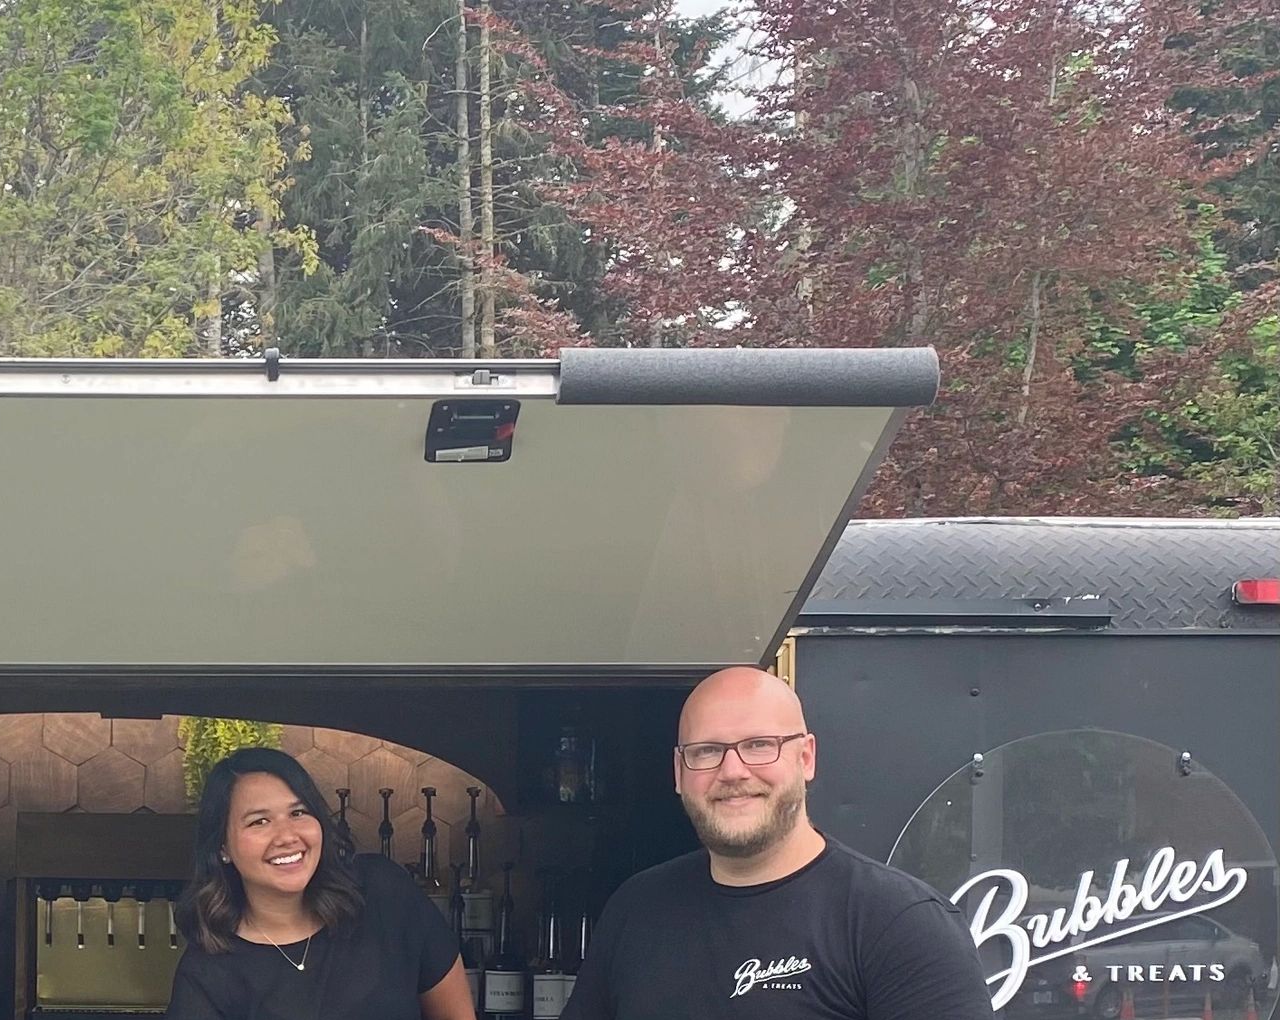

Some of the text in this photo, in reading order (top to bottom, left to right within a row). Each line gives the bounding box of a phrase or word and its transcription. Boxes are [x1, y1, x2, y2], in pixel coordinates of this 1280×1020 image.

[950, 847, 1247, 1012] Bubbles
[729, 955, 812, 999] Bubbles
[1072, 963, 1226, 983] & TREATS
